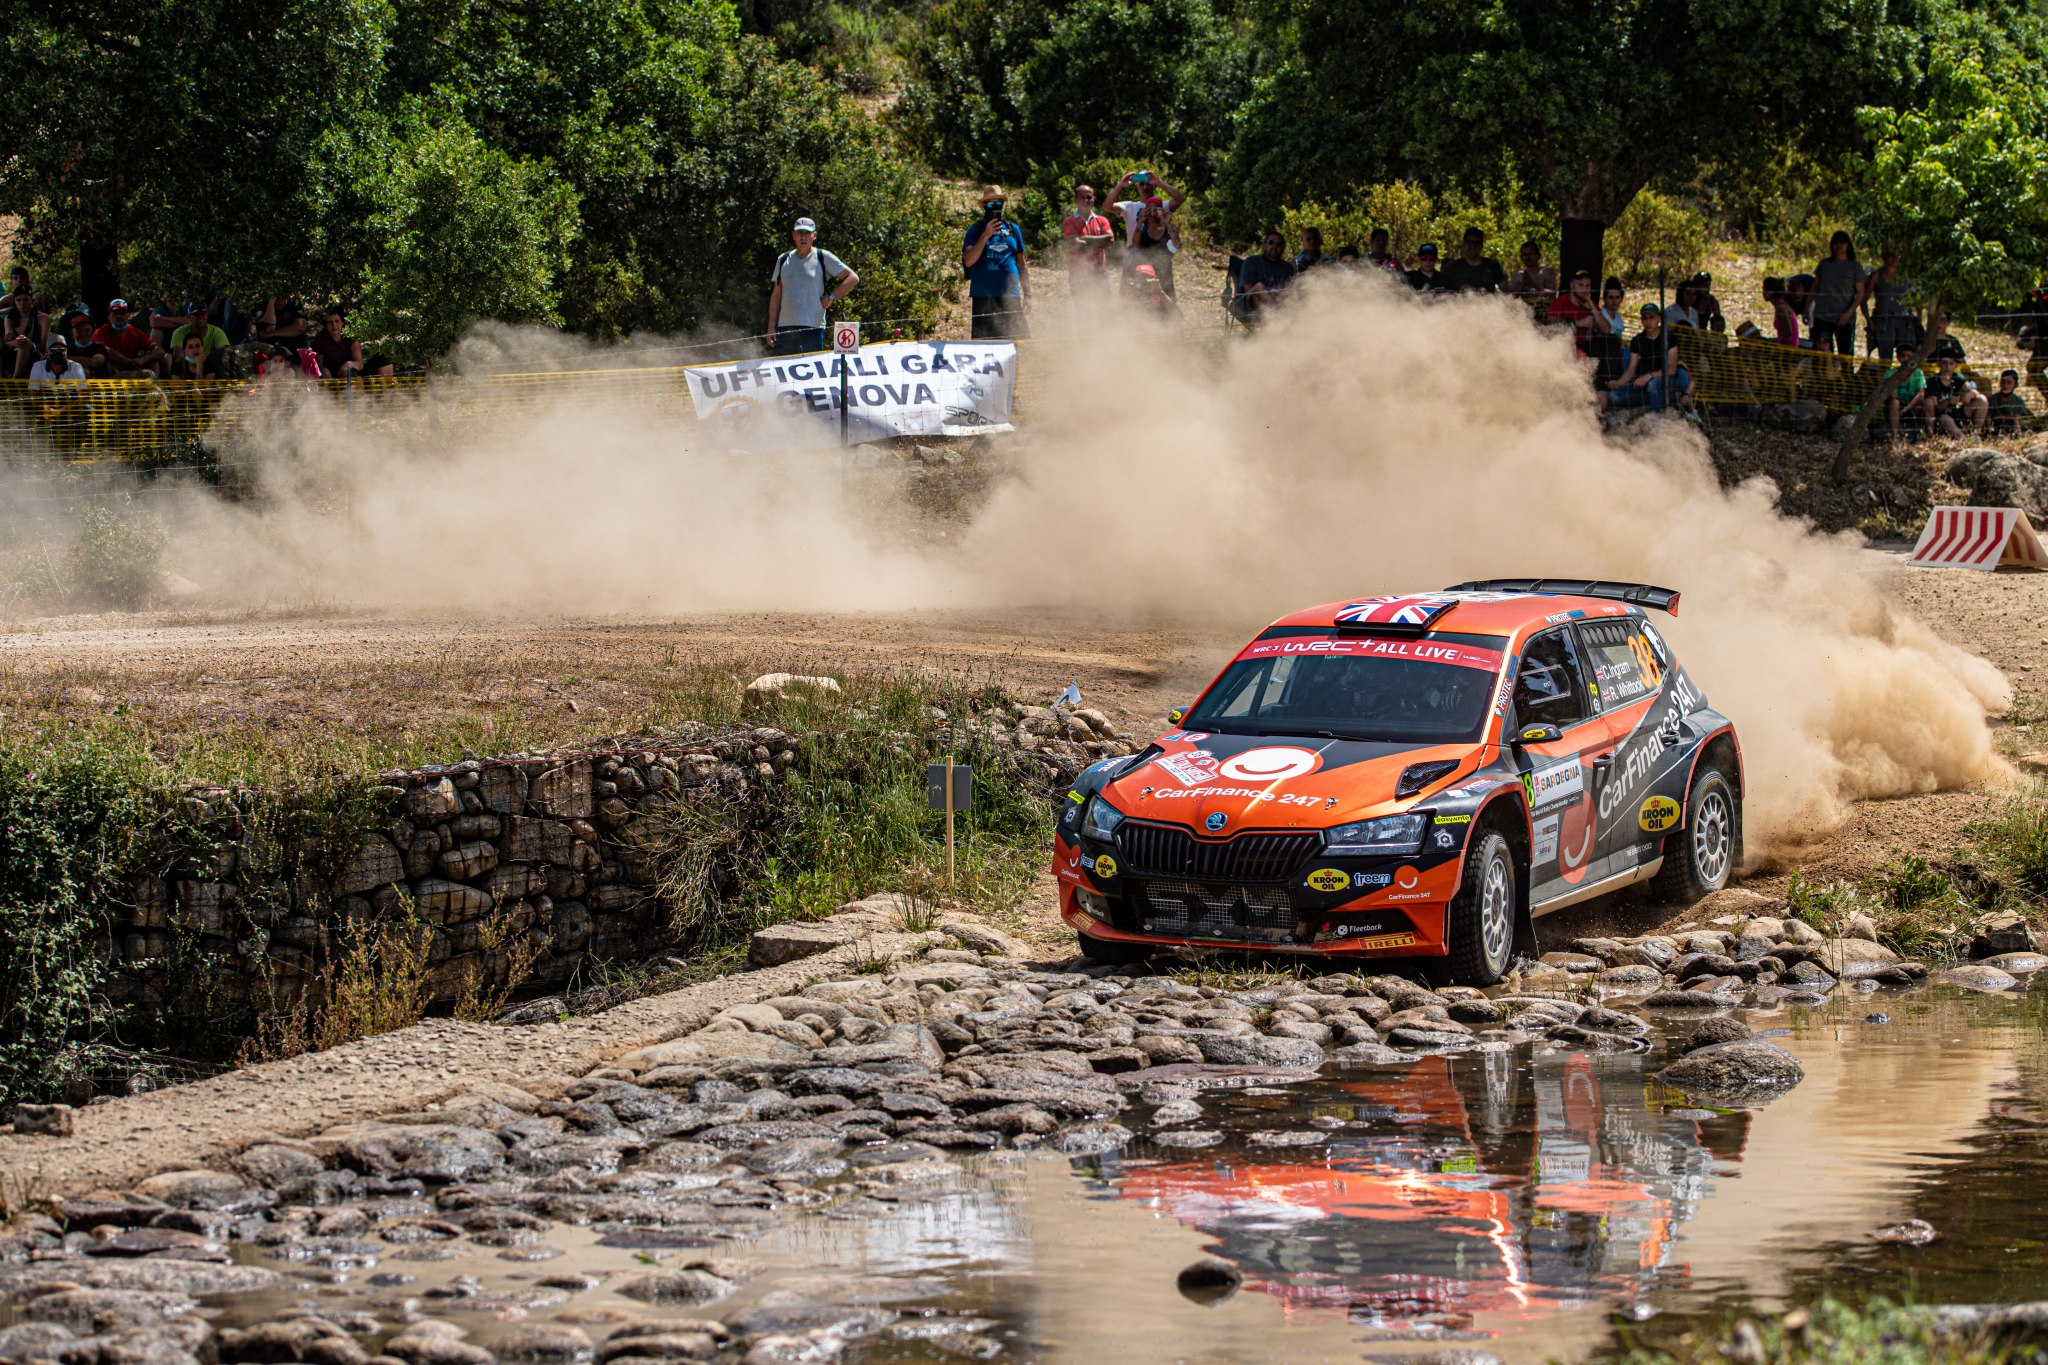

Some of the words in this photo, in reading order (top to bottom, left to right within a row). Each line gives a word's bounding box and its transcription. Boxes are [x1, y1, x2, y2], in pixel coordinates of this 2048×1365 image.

[699, 355, 889, 399] UFFICIALI
[901, 352, 1005, 379] GARA
[776, 382, 938, 414] GENOVA
[1253, 645, 1272, 653] WRC
[1373, 642, 1410, 656] ALL
[1414, 645, 1458, 660] LIVE
[1627, 633, 1662, 689] 38
[1497, 678, 1512, 710] PROTEC
[1600, 708, 1680, 819] CarFinance
[1670, 673, 1697, 720] 247
[1541, 766, 1580, 790] SARDEGNA
[1155, 786, 1275, 800] CarFinance
[1277, 793, 1321, 807] 247
[1642, 807, 1674, 820] KROON
[1647, 818, 1663, 830] OIL
[1313, 876, 1344, 884] KROON
[1354, 872, 1391, 887] freem
[1388, 892, 1420, 900] CarFinance
[1349, 923, 1382, 932] Fleetback
